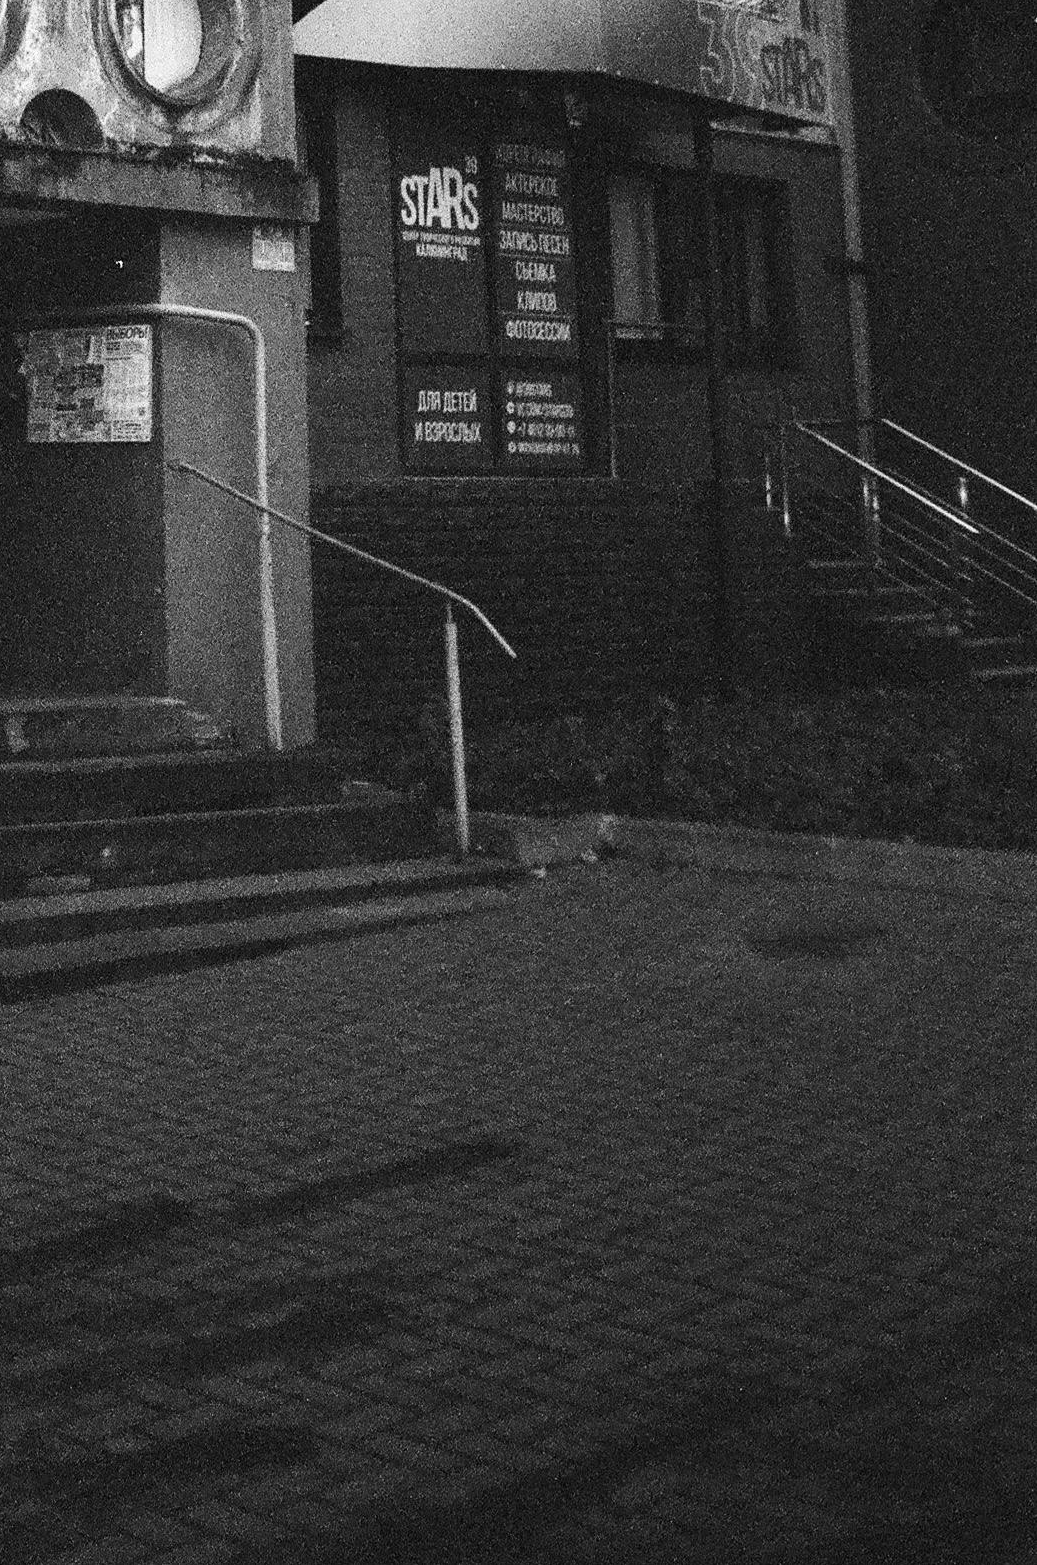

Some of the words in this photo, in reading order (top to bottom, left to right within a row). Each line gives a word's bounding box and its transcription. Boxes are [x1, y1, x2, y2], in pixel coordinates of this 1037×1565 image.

[761, 38, 827, 113] STARS
[400, 166, 480, 231] STARS
[502, 201, 564, 226] МАСТЕРСТВО
[499, 230, 538, 252] ЗАПИСЬ
[538, 233, 570, 256] ПЕСЕН
[515, 260, 558, 283] СЪЕМКА
[517, 290, 558, 312] КЛИПОВ
[418, 390, 442, 413] ДЛЯ
[443, 388, 477, 413] ДЕТЕЙ
[414, 421, 424, 442] И
[425, 421, 482, 443] ВЗРОСЛЫХ
